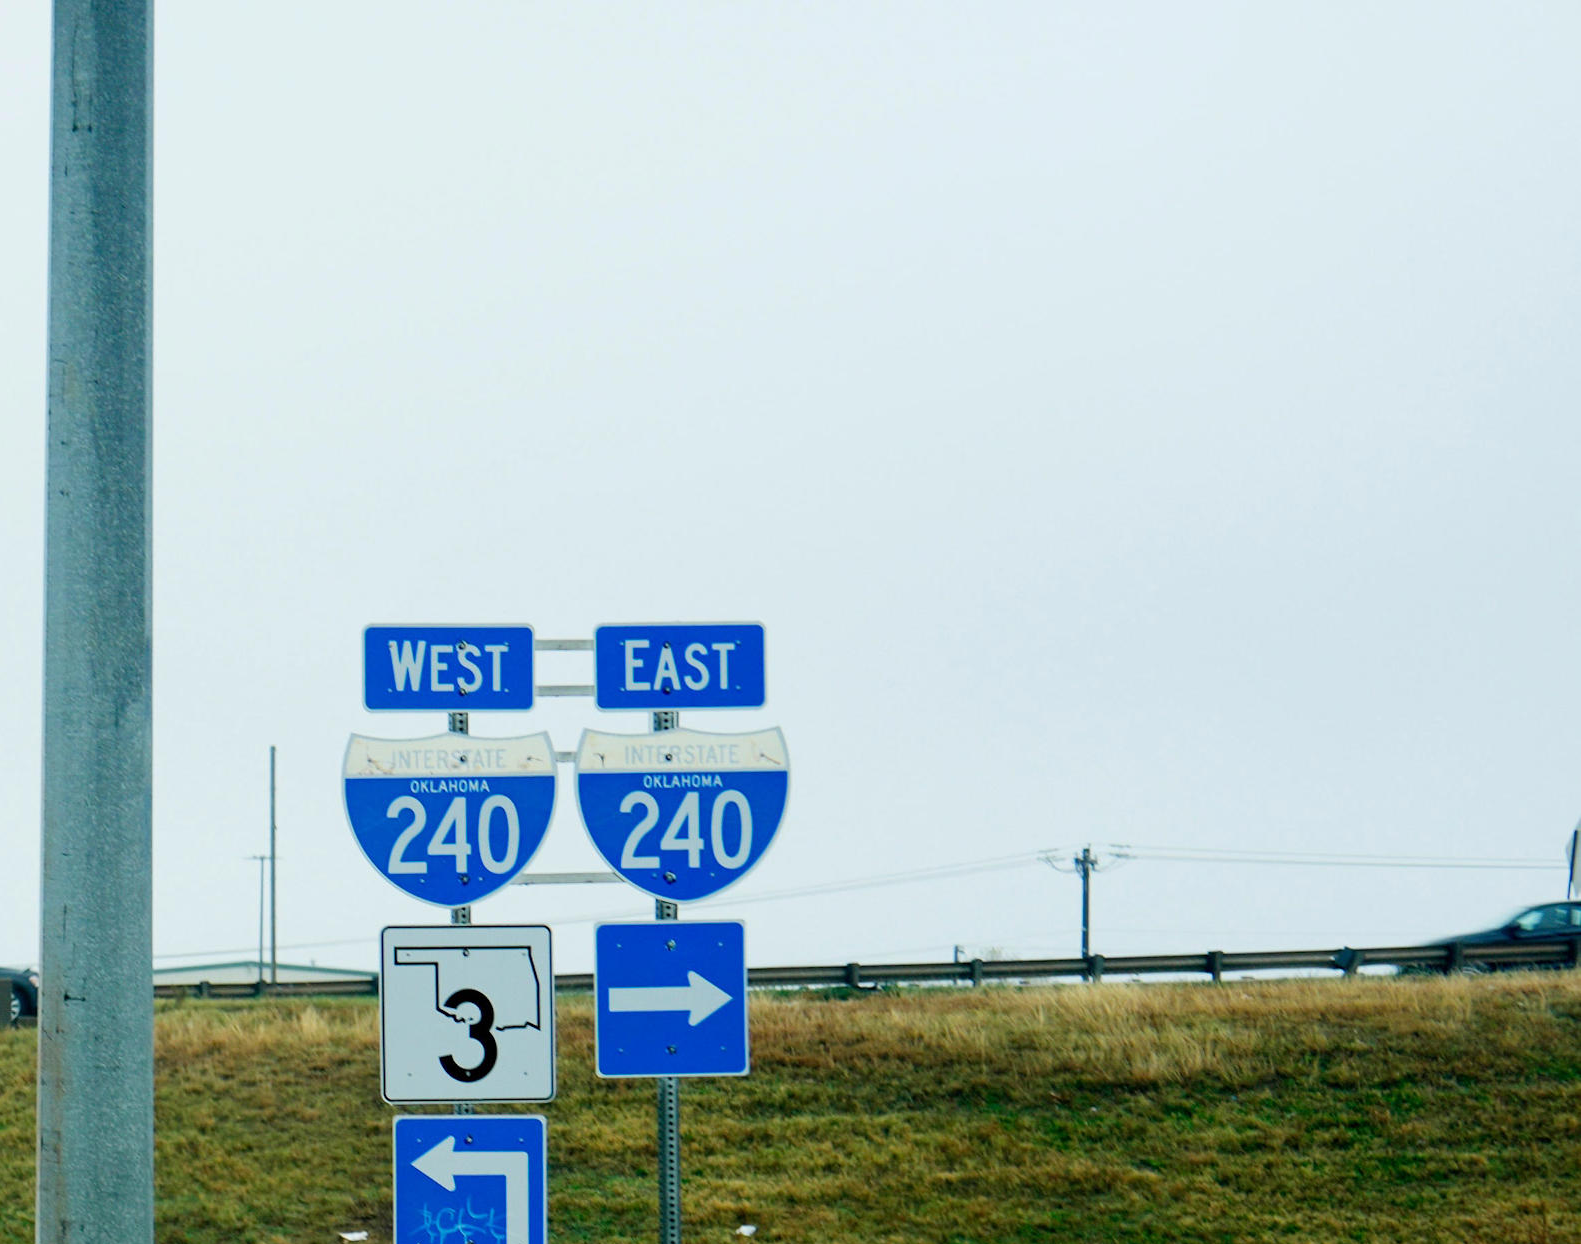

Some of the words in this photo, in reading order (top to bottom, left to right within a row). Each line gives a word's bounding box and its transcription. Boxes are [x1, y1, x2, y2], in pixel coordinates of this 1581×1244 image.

[388, 639, 510, 693] WEST
[623, 638, 737, 692] EAST
[391, 748, 508, 770] INTERSTATE
[624, 743, 740, 766] INTERSTATE
[642, 774, 724, 789] OKLAHOMA
[410, 779, 491, 794] OKLAHOMA
[386, 794, 521, 876] 240
[618, 789, 754, 870] 240
[437, 987, 500, 1084] 3
